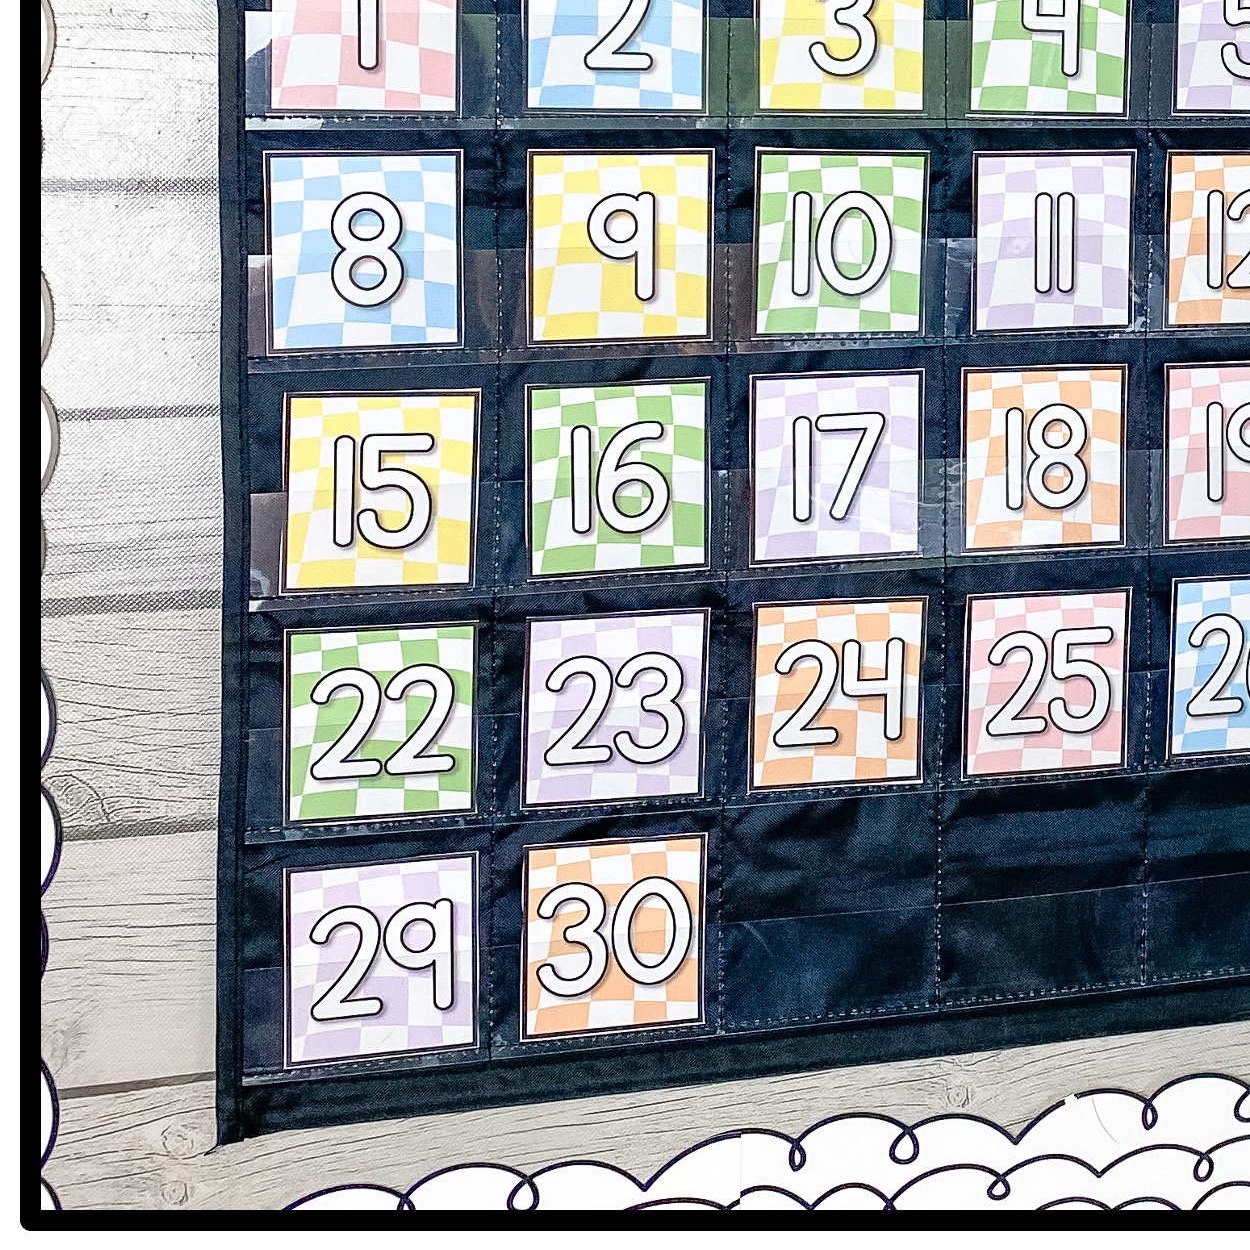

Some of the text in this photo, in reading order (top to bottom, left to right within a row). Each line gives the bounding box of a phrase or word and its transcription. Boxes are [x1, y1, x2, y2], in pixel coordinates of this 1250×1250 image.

[330, 190, 405, 308] 8
[586, 191, 656, 302] 9
[789, 189, 892, 298] 10
[1033, 191, 1076, 295] 11
[332, 431, 436, 550] 15
[570, 420, 670, 536] 16
[791, 412, 886, 523] 17
[1004, 402, 1089, 512] 18
[309, 662, 456, 781] 22
[543, 651, 686, 768] 23
[772, 636, 905, 749] 24
[986, 625, 1115, 738] 25
[309, 897, 455, 1022] 29
[535, 875, 692, 998] 30
